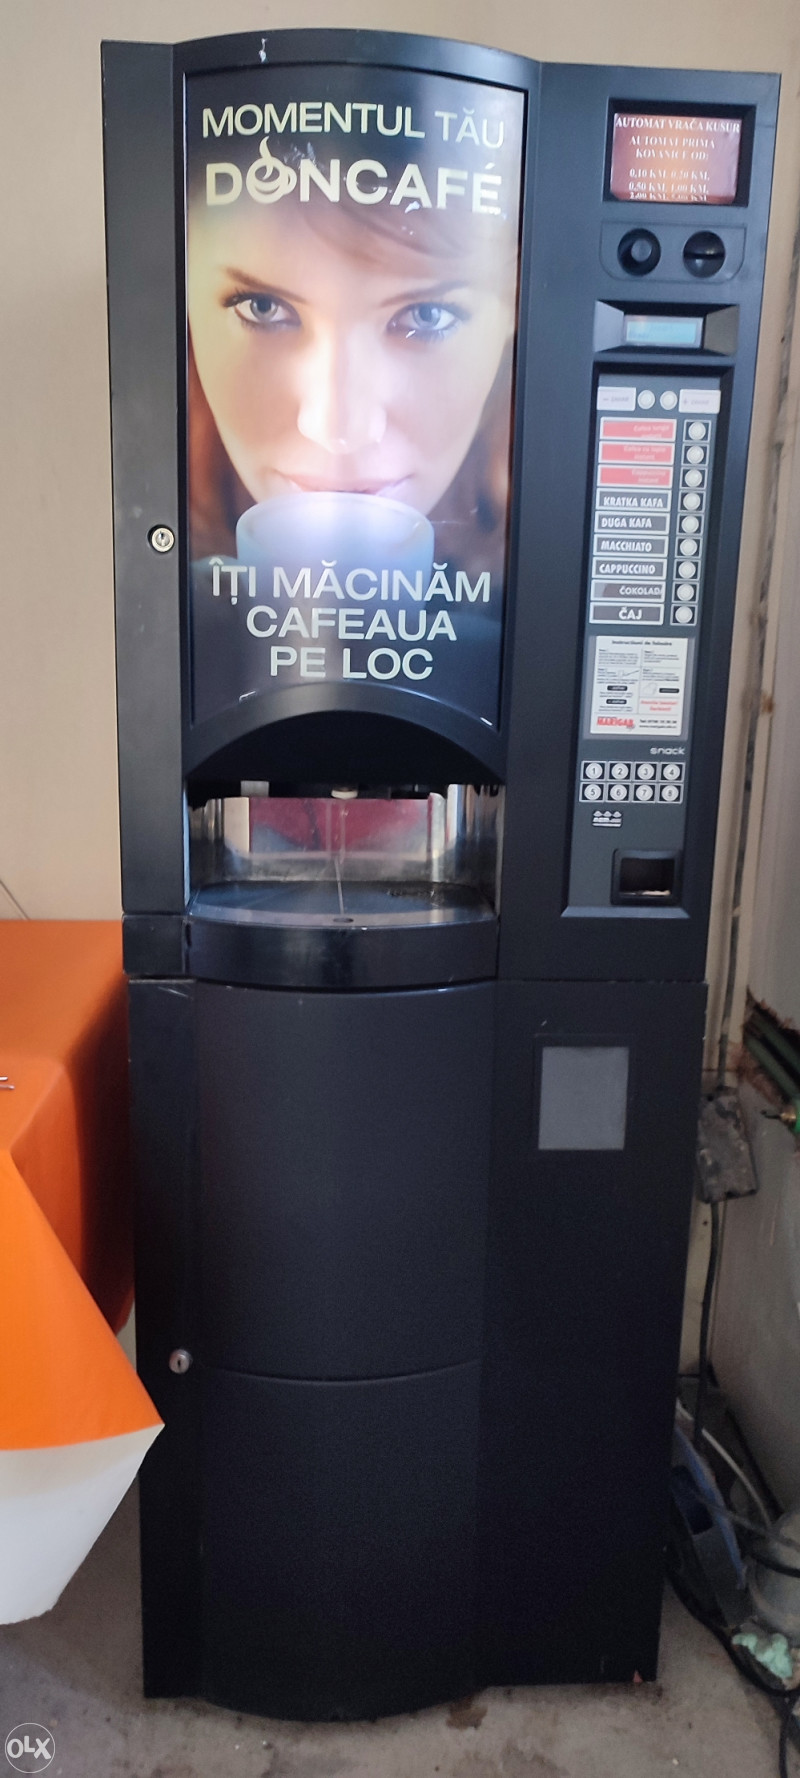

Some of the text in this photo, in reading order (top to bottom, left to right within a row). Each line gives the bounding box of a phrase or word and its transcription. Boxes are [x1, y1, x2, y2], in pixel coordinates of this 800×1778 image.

[202, 102, 504, 148] MOMENTUL TĂU
[615, 117, 740, 133] AUTOMAT VRAČA KUSUR
[630, 135, 715, 149] AUTOMAT PRIMA
[635, 148, 709, 161] KOVANICE OD:
[206, 158, 502, 214] DONCAFÉ
[603, 496, 664, 508] KRATKA KAFA
[601, 517, 652, 528] DUGA KAFA
[600, 540, 652, 552] MACCHIATO
[599, 563, 656, 575] CAPPUCCINO
[272, 559, 491, 603] MĂCINĂM
[618, 606, 643, 620] ČAJ
[246, 605, 457, 641] CAFEAUA
[270, 646, 433, 680] PE LOC
[650, 746, 685, 755] snack
[592, 767, 674, 776] 1 2 3 4
[590, 788, 673, 798] 5 6 7 8
